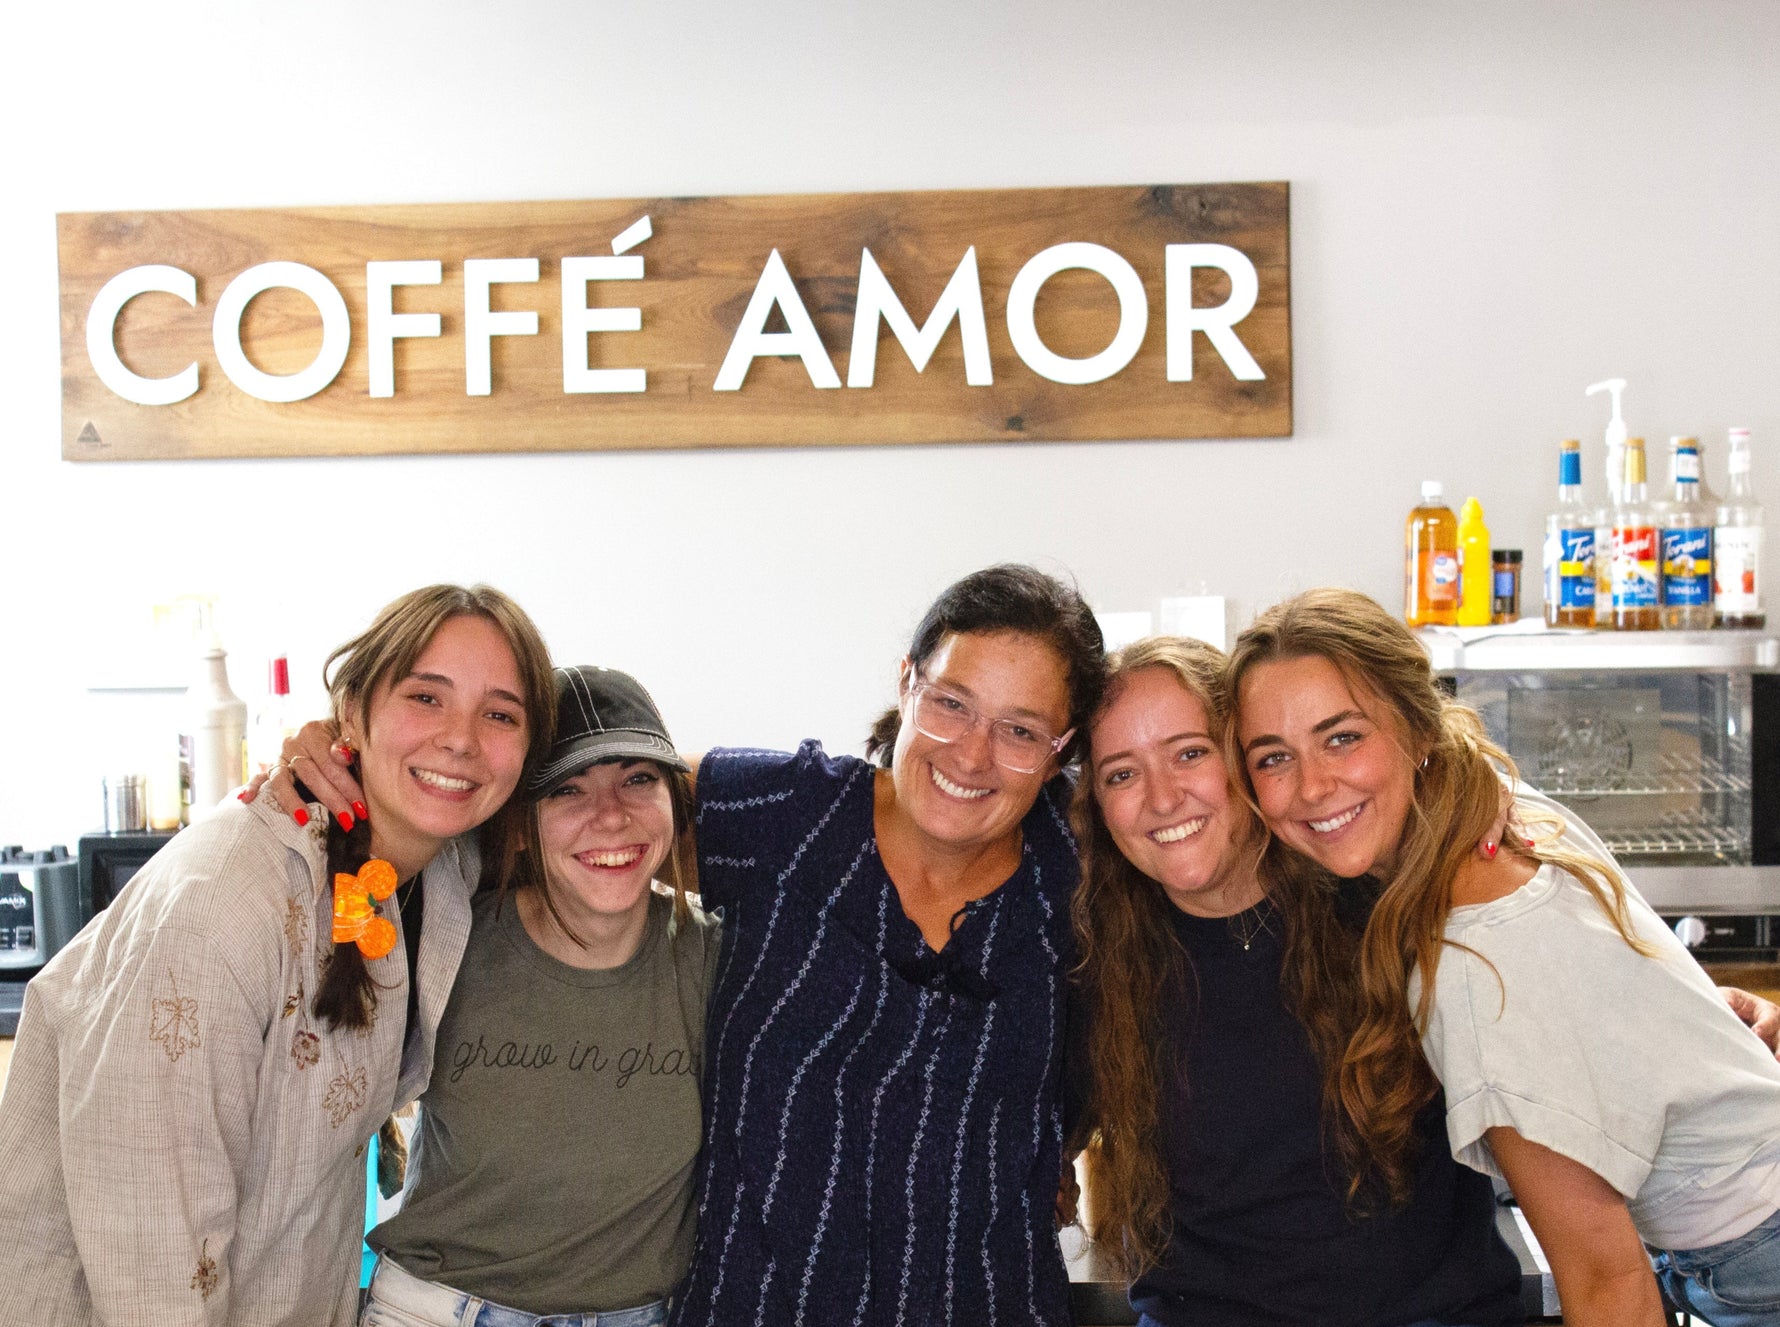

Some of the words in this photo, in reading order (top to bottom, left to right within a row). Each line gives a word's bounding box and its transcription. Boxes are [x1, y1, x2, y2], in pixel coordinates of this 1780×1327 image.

[86, 214, 653, 406] COFFÉ
[712, 241, 1267, 392] AMOR
[450, 1034, 558, 1084] grow
[568, 1039, 609, 1072] in
